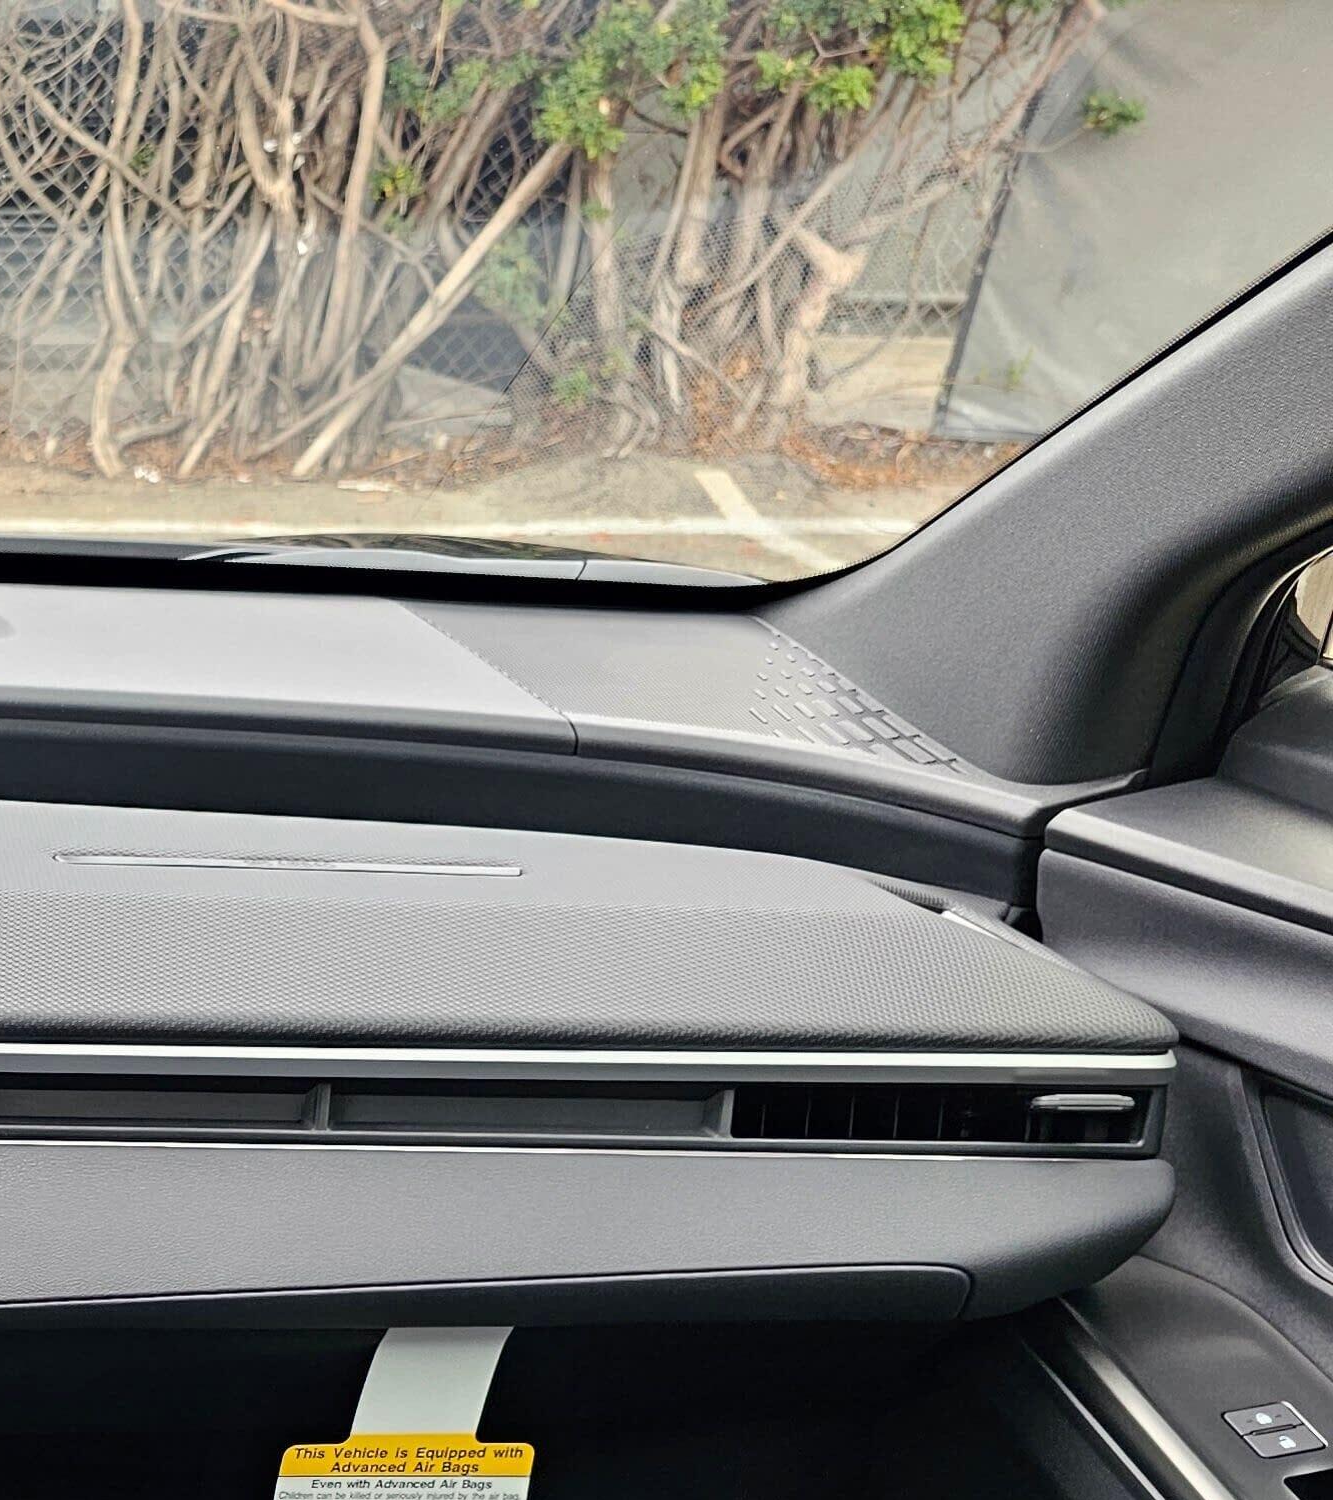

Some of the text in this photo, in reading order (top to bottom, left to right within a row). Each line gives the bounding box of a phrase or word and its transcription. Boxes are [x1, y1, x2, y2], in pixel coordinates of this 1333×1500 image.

[294, 1446, 524, 1461] This Vehicle is Equipped with
[330, 1461, 480, 1476] Advanced Air Bags
[311, 1479, 493, 1491] Even with Advanced Air Bags
[278, 1491, 313, 1500] Children
[335, 1492, 347, 1500] be
[349, 1492, 371, 1500] killed
[488, 1493, 500, 1500] air
